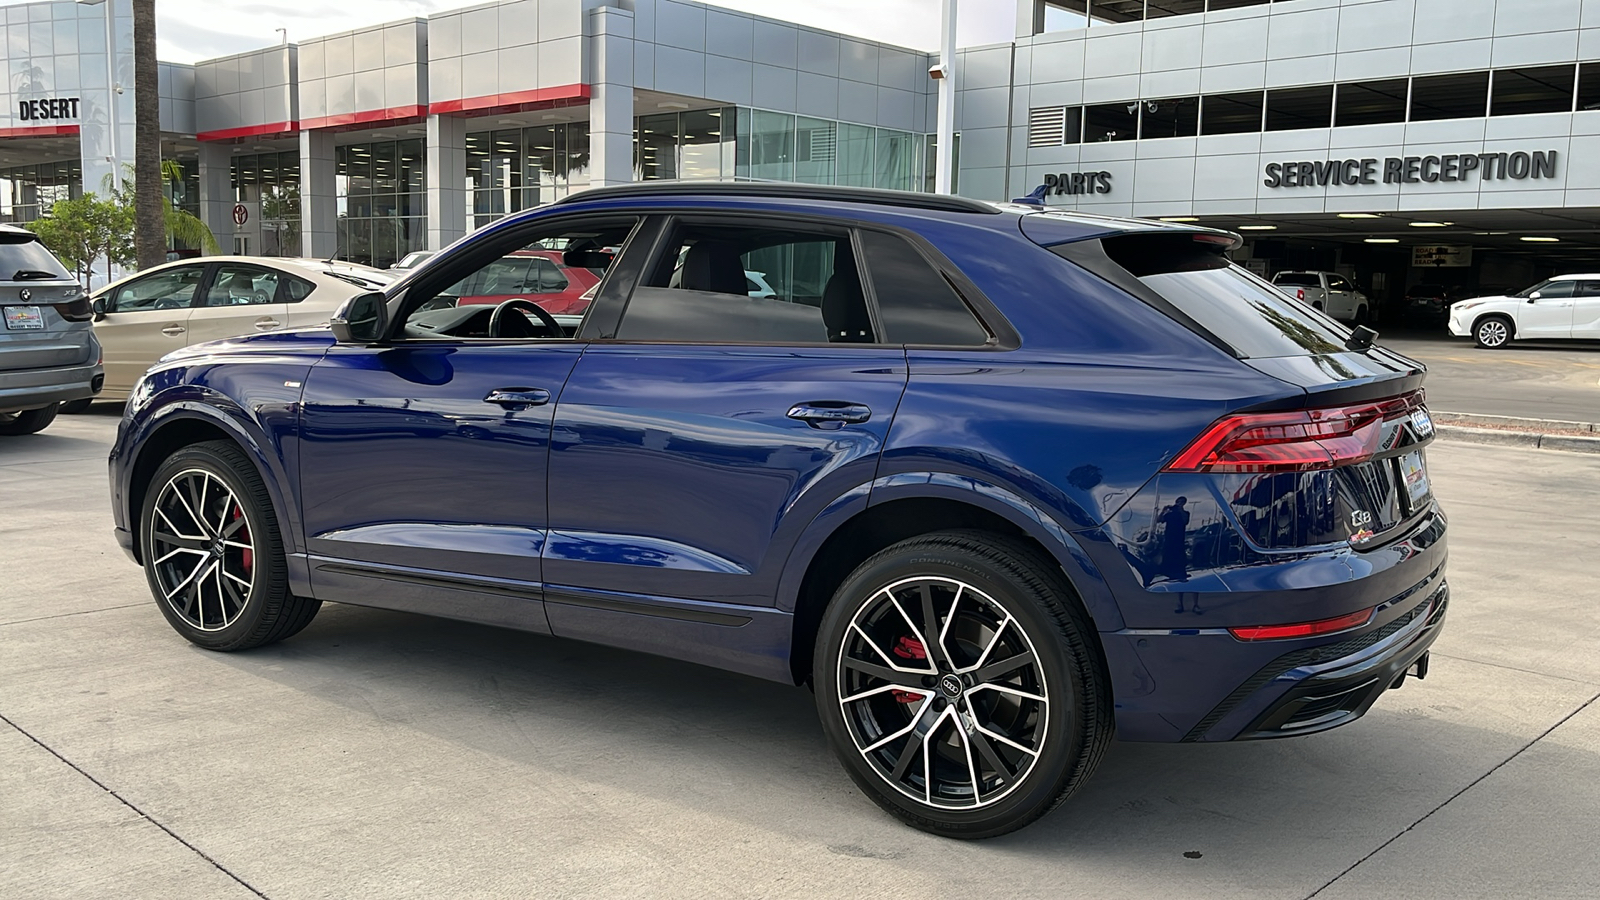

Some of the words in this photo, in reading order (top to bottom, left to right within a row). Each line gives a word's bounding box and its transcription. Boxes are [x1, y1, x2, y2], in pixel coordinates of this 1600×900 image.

[19, 98, 80, 121] DESERT
[1264, 158, 1377, 188] SERVICE
[1383, 150, 1557, 184] RECEPTION
[1044, 171, 1112, 195] PARTS
[1351, 509, 1372, 527] Q8
